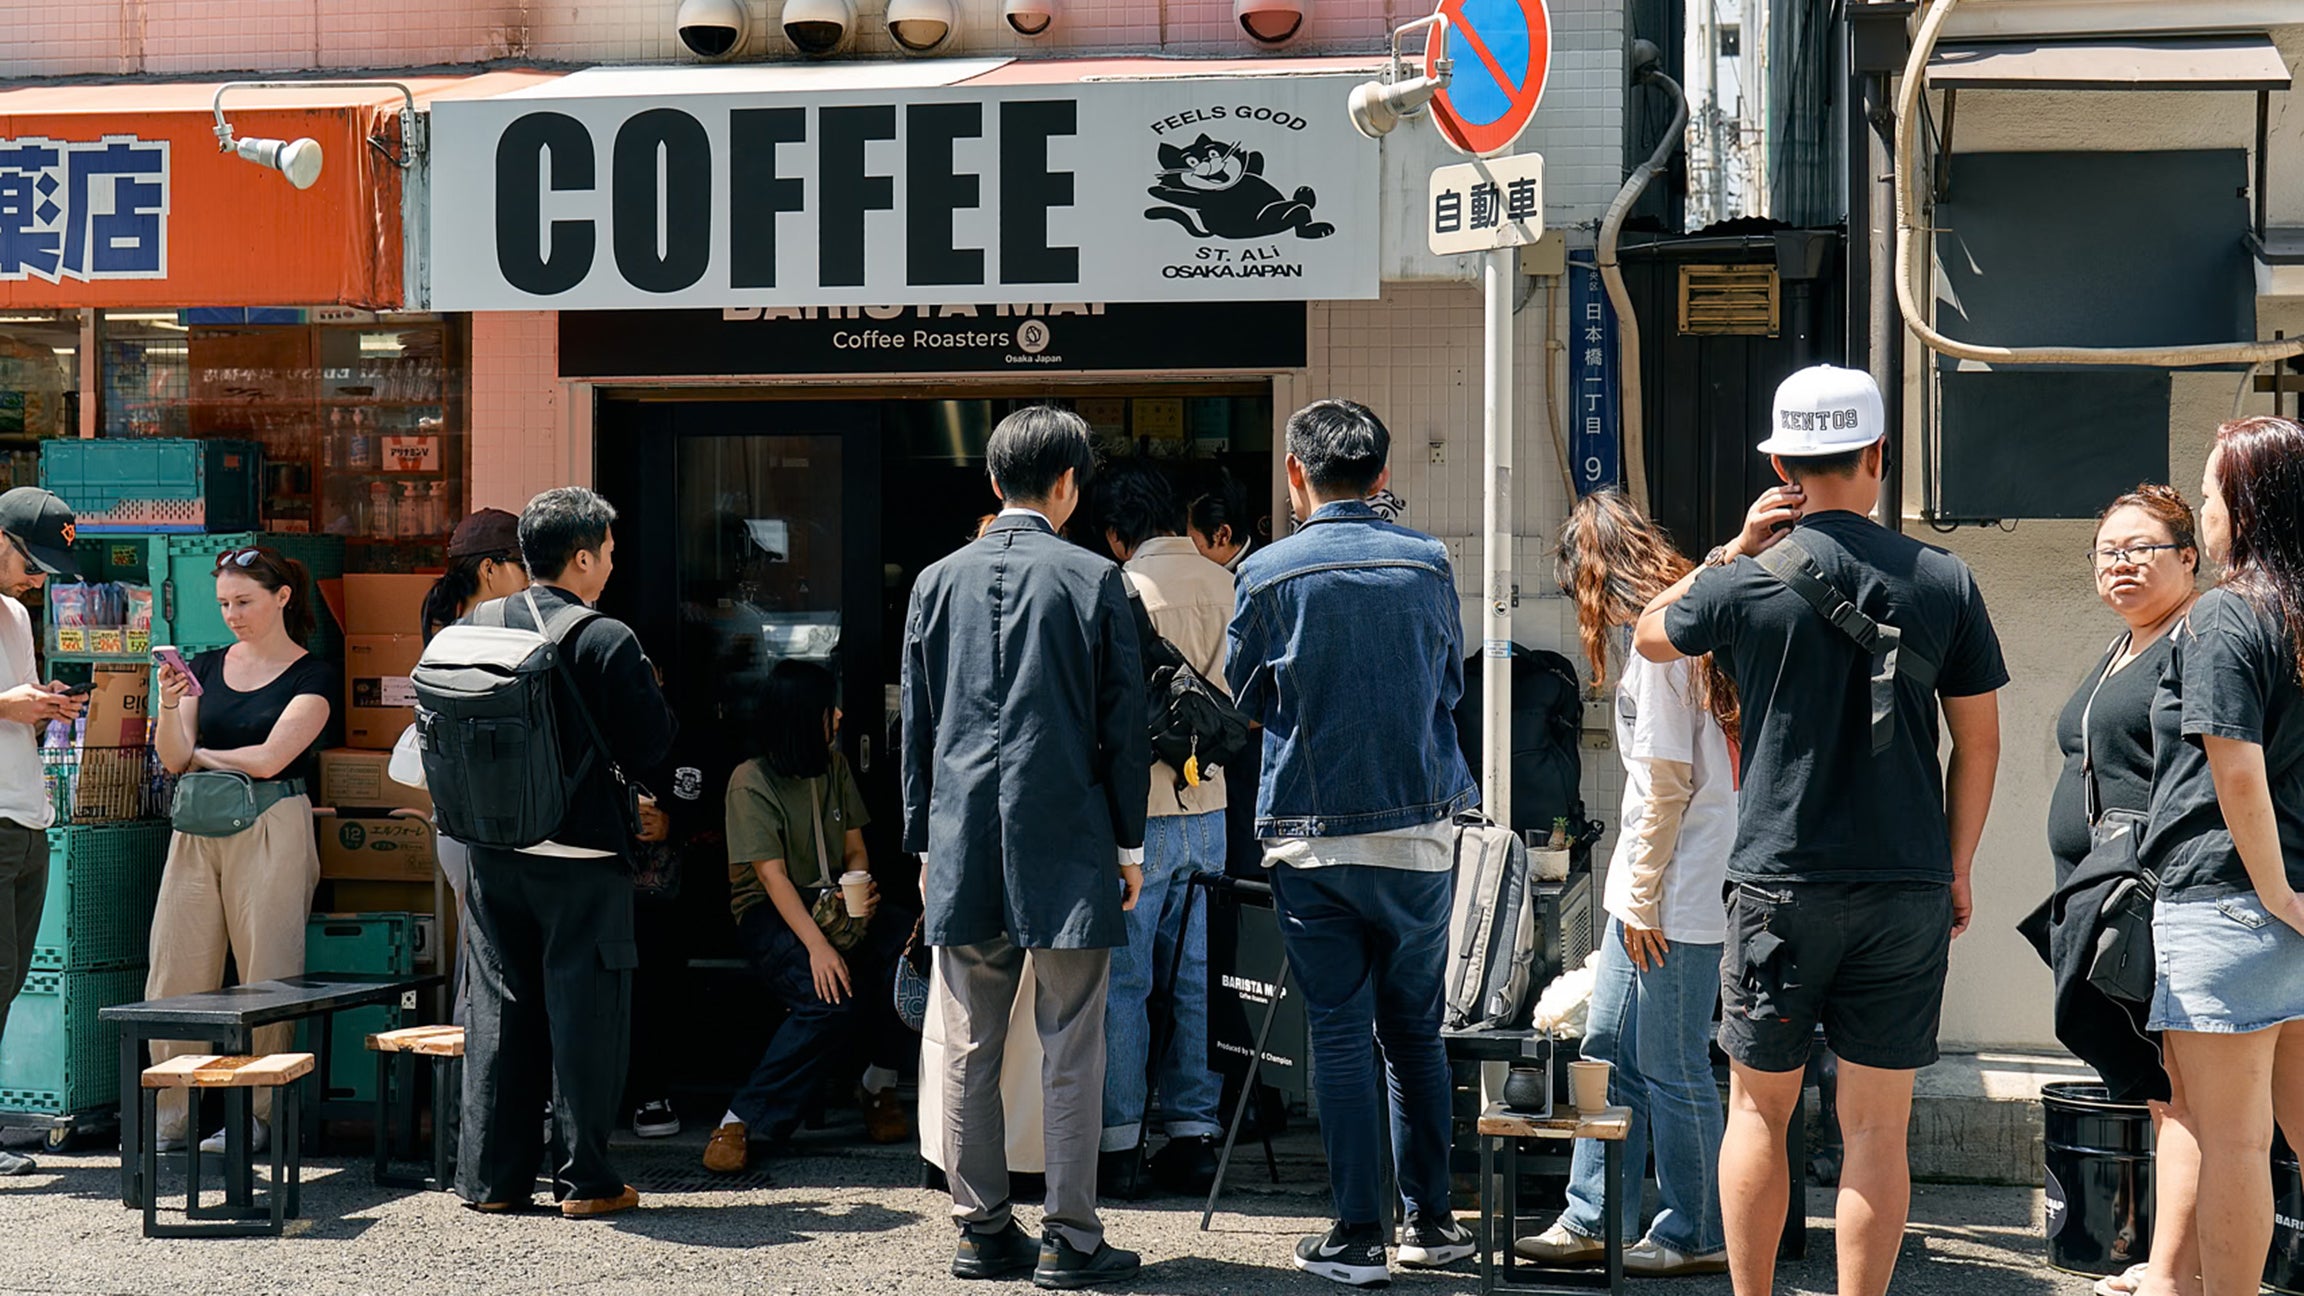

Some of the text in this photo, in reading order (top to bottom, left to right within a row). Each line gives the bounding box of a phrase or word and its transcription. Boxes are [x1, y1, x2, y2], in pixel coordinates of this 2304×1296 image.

[1150, 105, 1307, 135] FEELS GOOD
[496, 99, 1079, 296] COFFEE
[1435, 176, 1537, 234] 自動車
[1195, 247, 1231, 262] ST.
[1162, 264, 1302, 279] OSAKA JAPAN
[833, 330, 1010, 349] Coffee Roasters
[1005, 354, 1062, 364] Osaka Japan
[1585, 302, 1603, 435] 日本橋一丁目
[1584, 456, 1602, 482] 9
[344, 826, 361, 841] 12
[1222, 974, 1288, 1000] BARISTA MP
[1217, 1040, 1241, 1054] Produced
[1242, 1046, 1249, 1056] by
[1266, 1052, 1293, 1067] Champion
